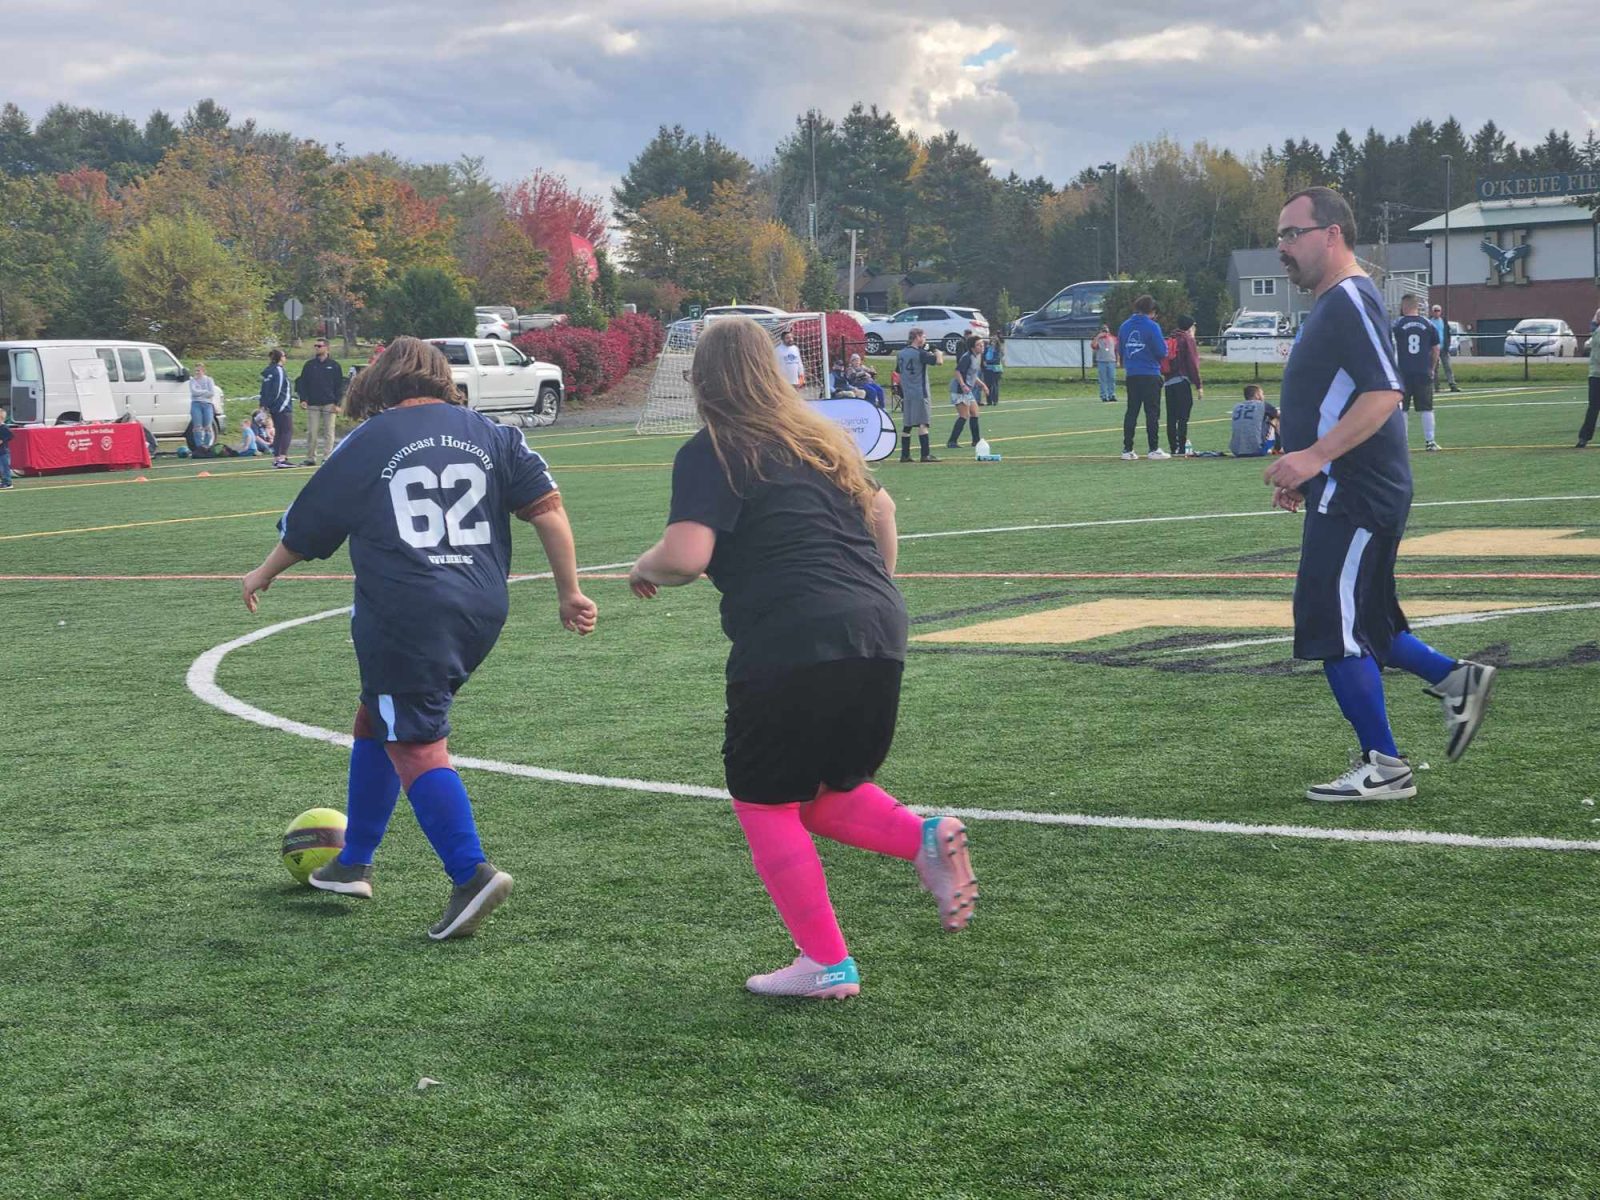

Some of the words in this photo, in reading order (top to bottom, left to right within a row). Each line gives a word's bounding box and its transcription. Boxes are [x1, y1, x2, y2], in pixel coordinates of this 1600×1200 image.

[1482, 176, 1561, 196] O'KEEFE
[1566, 173, 1600, 190] FIE
[1407, 333, 1421, 355] 8
[380, 436, 436, 481] Downeast
[440, 434, 495, 471] Horizons
[389, 463, 491, 548] 62
